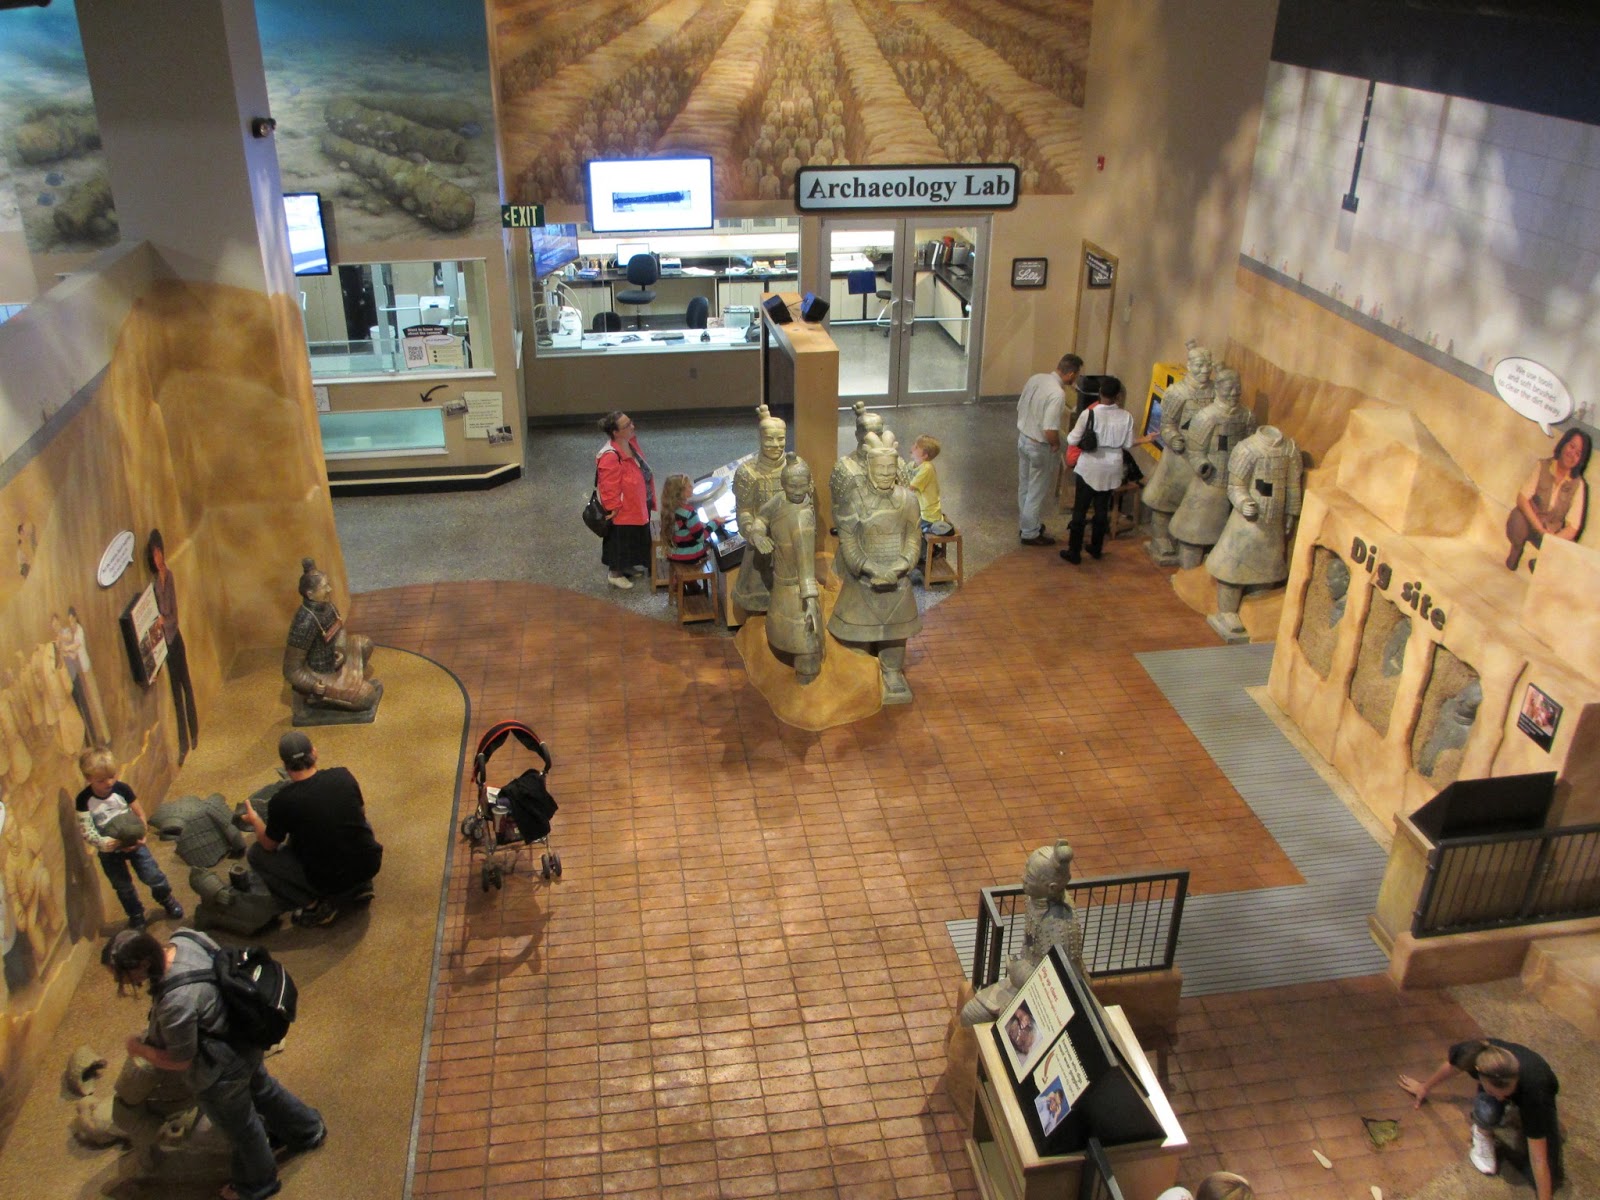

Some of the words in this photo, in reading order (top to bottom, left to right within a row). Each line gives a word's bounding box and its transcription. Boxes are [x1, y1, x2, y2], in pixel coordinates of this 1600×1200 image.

[807, 176, 957, 203] Archaeology
[965, 174, 1010, 196] Lab
[510, 205, 538, 227] EXIT
[1015, 268, 1042, 284] Lilly
[1507, 373, 1520, 383] and
[1532, 384, 1557, 403] brushes
[1350, 536, 1393, 591] Dig
[1400, 581, 1446, 631] site
